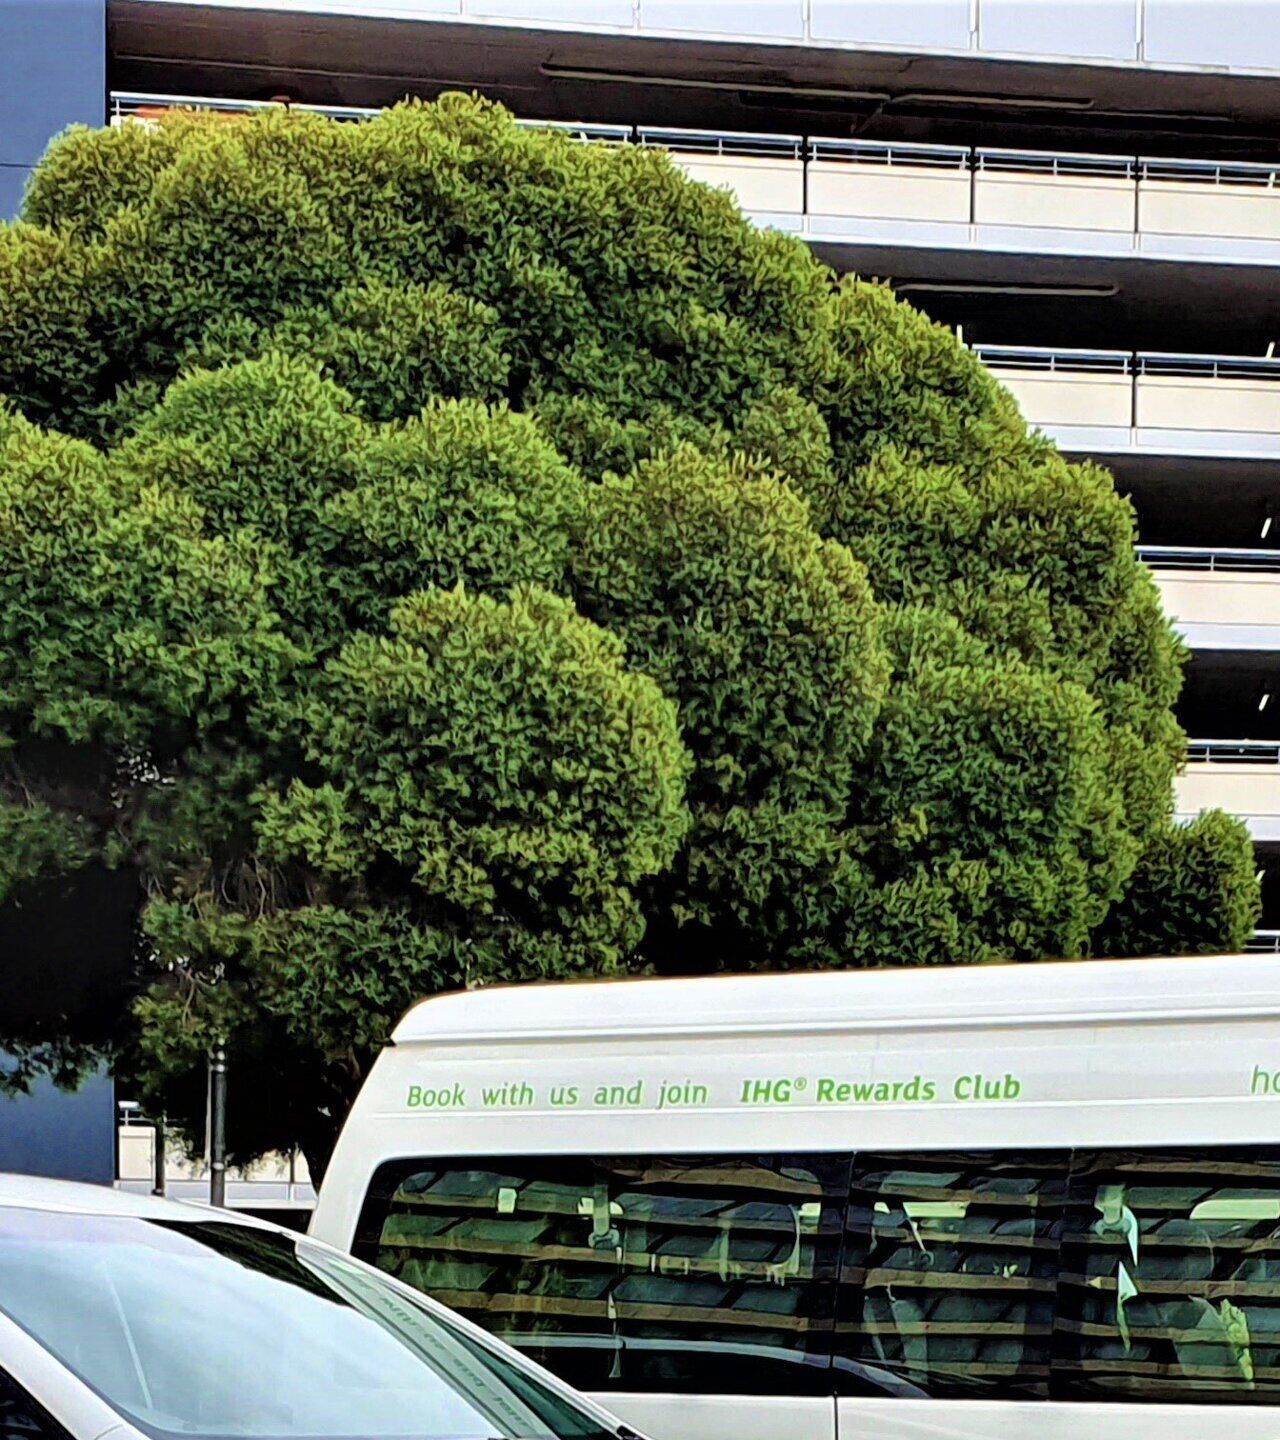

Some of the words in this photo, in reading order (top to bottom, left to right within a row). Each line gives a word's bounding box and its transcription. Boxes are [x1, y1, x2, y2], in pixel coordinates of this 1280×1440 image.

[407, 1083, 465, 1107] Book
[482, 1081, 534, 1106] with
[550, 1085, 578, 1106] us
[594, 1080, 642, 1106] and
[658, 1079, 708, 1110] join
[816, 1075, 936, 1102] Rewards
[953, 1074, 1020, 1100] Club
